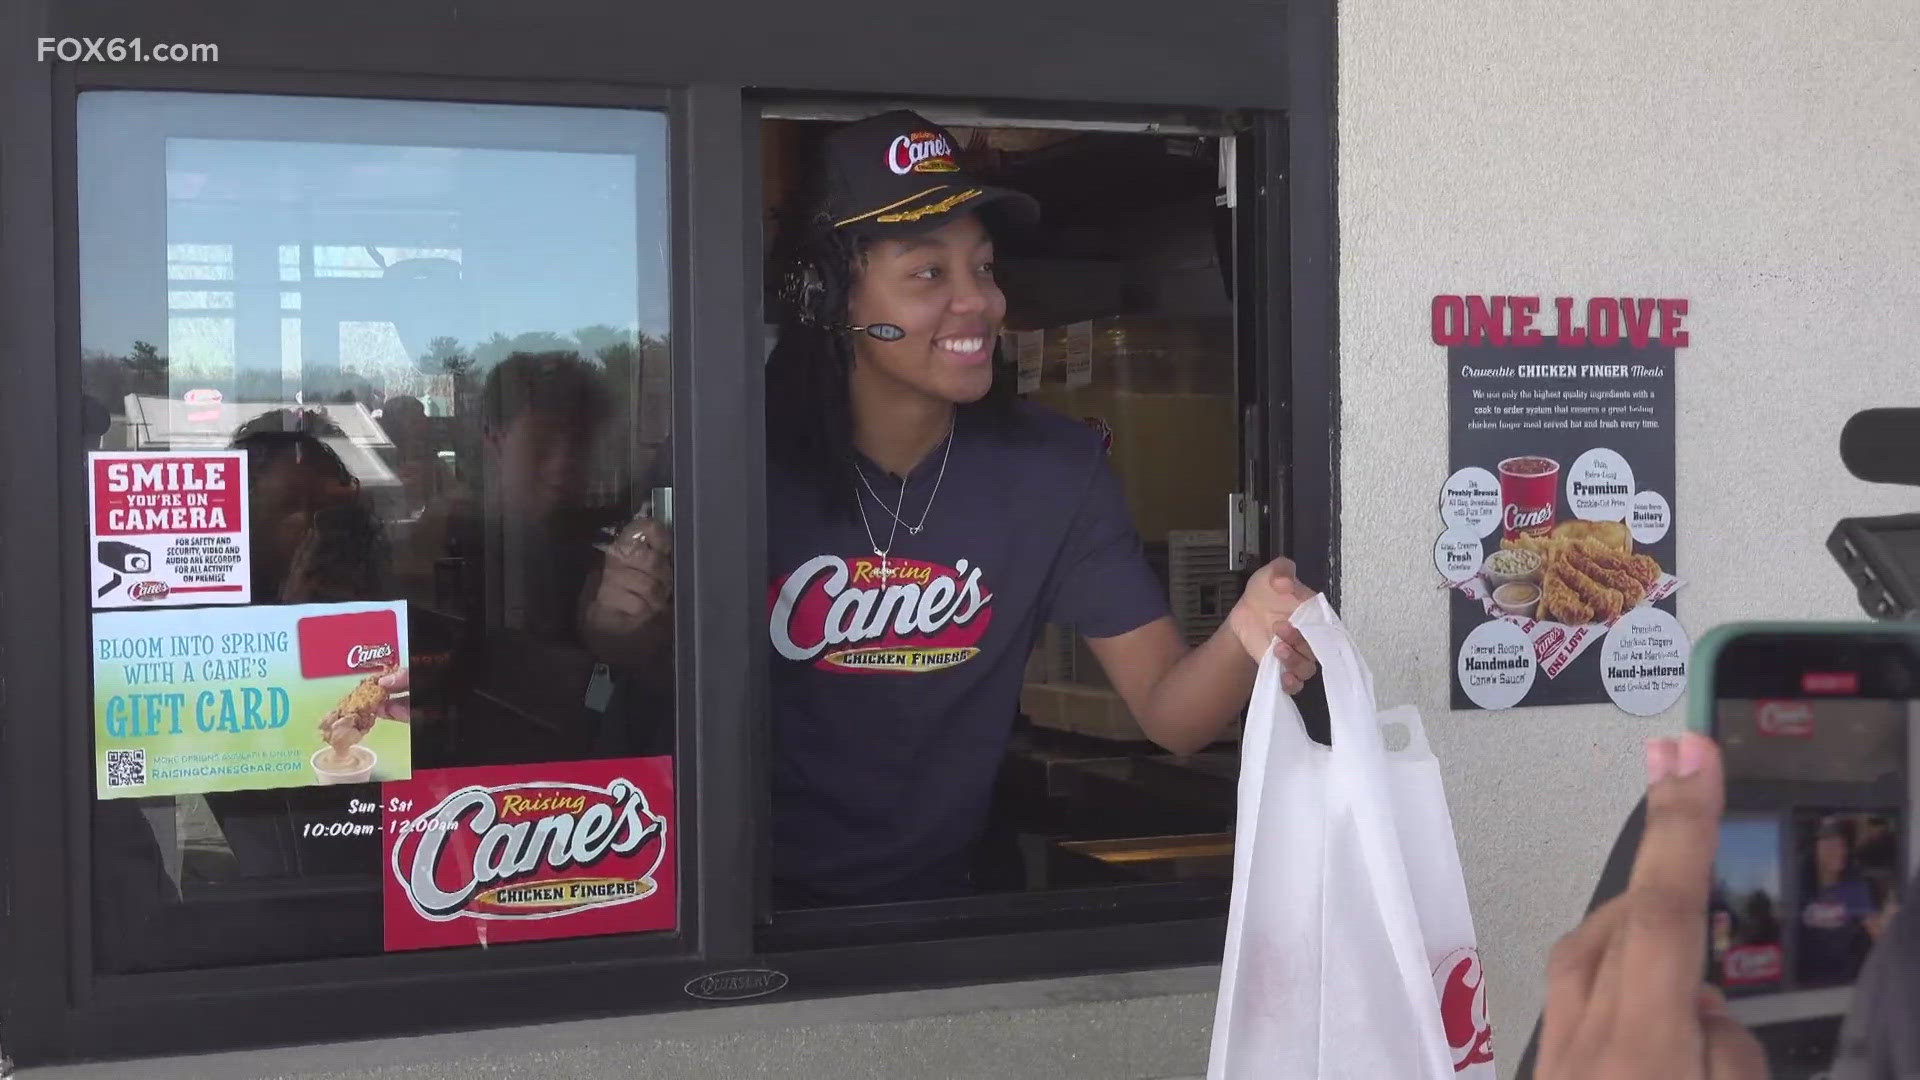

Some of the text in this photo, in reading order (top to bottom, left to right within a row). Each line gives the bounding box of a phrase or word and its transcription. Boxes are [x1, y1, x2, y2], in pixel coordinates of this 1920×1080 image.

[889, 133, 951, 175] Cane's
[1431, 295, 1689, 348] ONE LOVE
[1518, 365, 1577, 377] CHICKEN
[1581, 365, 1629, 378] FINGER
[1472, 389, 1485, 398] We
[1501, 389, 1518, 399] only
[1520, 389, 1531, 398] the
[1534, 389, 1561, 400] highest
[1562, 389, 1588, 400] quality
[1590, 389, 1630, 400] ingredients
[1632, 389, 1648, 398] with
[1474, 405, 1492, 414] cook
[1494, 406, 1501, 414] to
[1503, 405, 1524, 414] order
[1525, 406, 1552, 415] system
[1554, 404, 1569, 413] that
[1570, 419, 1581, 428] hot
[1584, 420, 1598, 428] and
[1600, 419, 1618, 428] fresh
[1620, 420, 1640, 430] every
[108, 462, 226, 492] SMILE
[1448, 489, 1471, 498] Freshly
[1573, 481, 1628, 495] Premium
[127, 493, 208, 507] YOU'RE ON
[109, 507, 227, 530] CAMERA
[1504, 502, 1552, 531] Cane's
[1633, 511, 1663, 521] Buttery
[175, 537, 231, 546] FOR SAFETY AND
[167, 546, 240, 556] SECURITY, VIDEO AND
[1447, 551, 1472, 562] Fresh
[166, 555, 241, 565] AUDIO ARE RECORDED
[175, 565, 233, 574] FOR ALL ACTIVITY
[183, 573, 225, 582] ON PREMISE
[853, 561, 932, 586] Raising
[769, 555, 993, 661] Cane's
[98, 631, 288, 660] BLOOM INTO SPRING
[1547, 627, 1589, 676] ONE LOVE
[347, 643, 394, 668] Cane's
[843, 653, 906, 664] CHICKEN
[1465, 655, 1529, 671] Handmade
[123, 657, 267, 685] WITH A CANE'S
[1608, 662, 1685, 678] Hand-battered
[106, 686, 290, 738] GIFT CARD
[348, 798, 375, 814] Sun
[389, 797, 413, 812] Sat
[501, 792, 586, 818] Raising
[303, 822, 374, 838] 10:00am
[389, 819, 458, 834] 12:00am
[409, 783, 659, 910] Cane's
[496, 882, 635, 904] CHICKEN FINGERS
